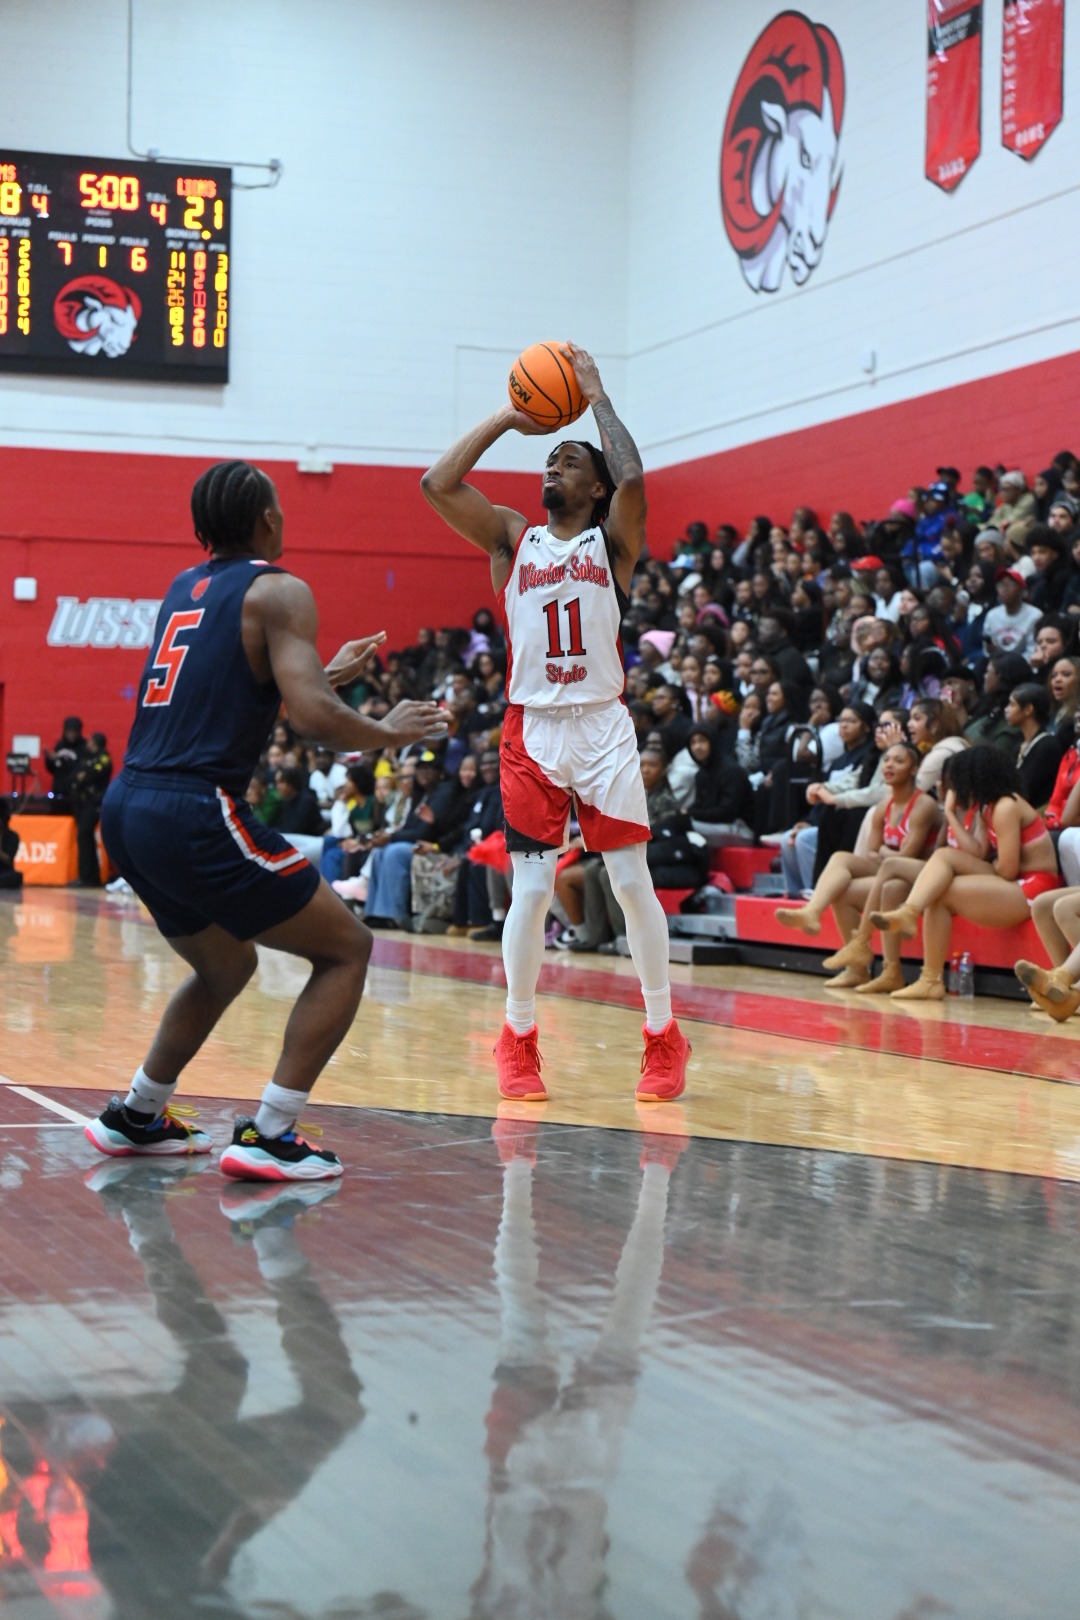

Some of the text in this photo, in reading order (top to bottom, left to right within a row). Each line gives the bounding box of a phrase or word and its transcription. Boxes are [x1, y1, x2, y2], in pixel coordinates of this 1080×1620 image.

[32, 194, 48, 216] 4
[150, 203, 167, 226] 4
[18, 238, 31, 258] 2
[57, 241, 72, 266] 7
[18, 258, 30, 277] 2
[131, 247, 148, 272] 6
[217, 253, 229, 273] 3
[17, 277, 30, 296] 0
[193, 270, 206, 289] 2
[18, 297, 30, 317] 2
[217, 291, 228, 310] 6
[17, 317, 30, 336] 4
[192, 308, 206, 327] 2
[216, 310, 227, 329] 0
[171, 326, 184, 346] 5
[213, 328, 225, 348] 0
[518, 554, 610, 596] Winston-Salem
[46, 596, 164, 648] WSS
[542, 597, 587, 658] 11
[142, 608, 206, 707] 5
[545, 662, 588, 685] State
